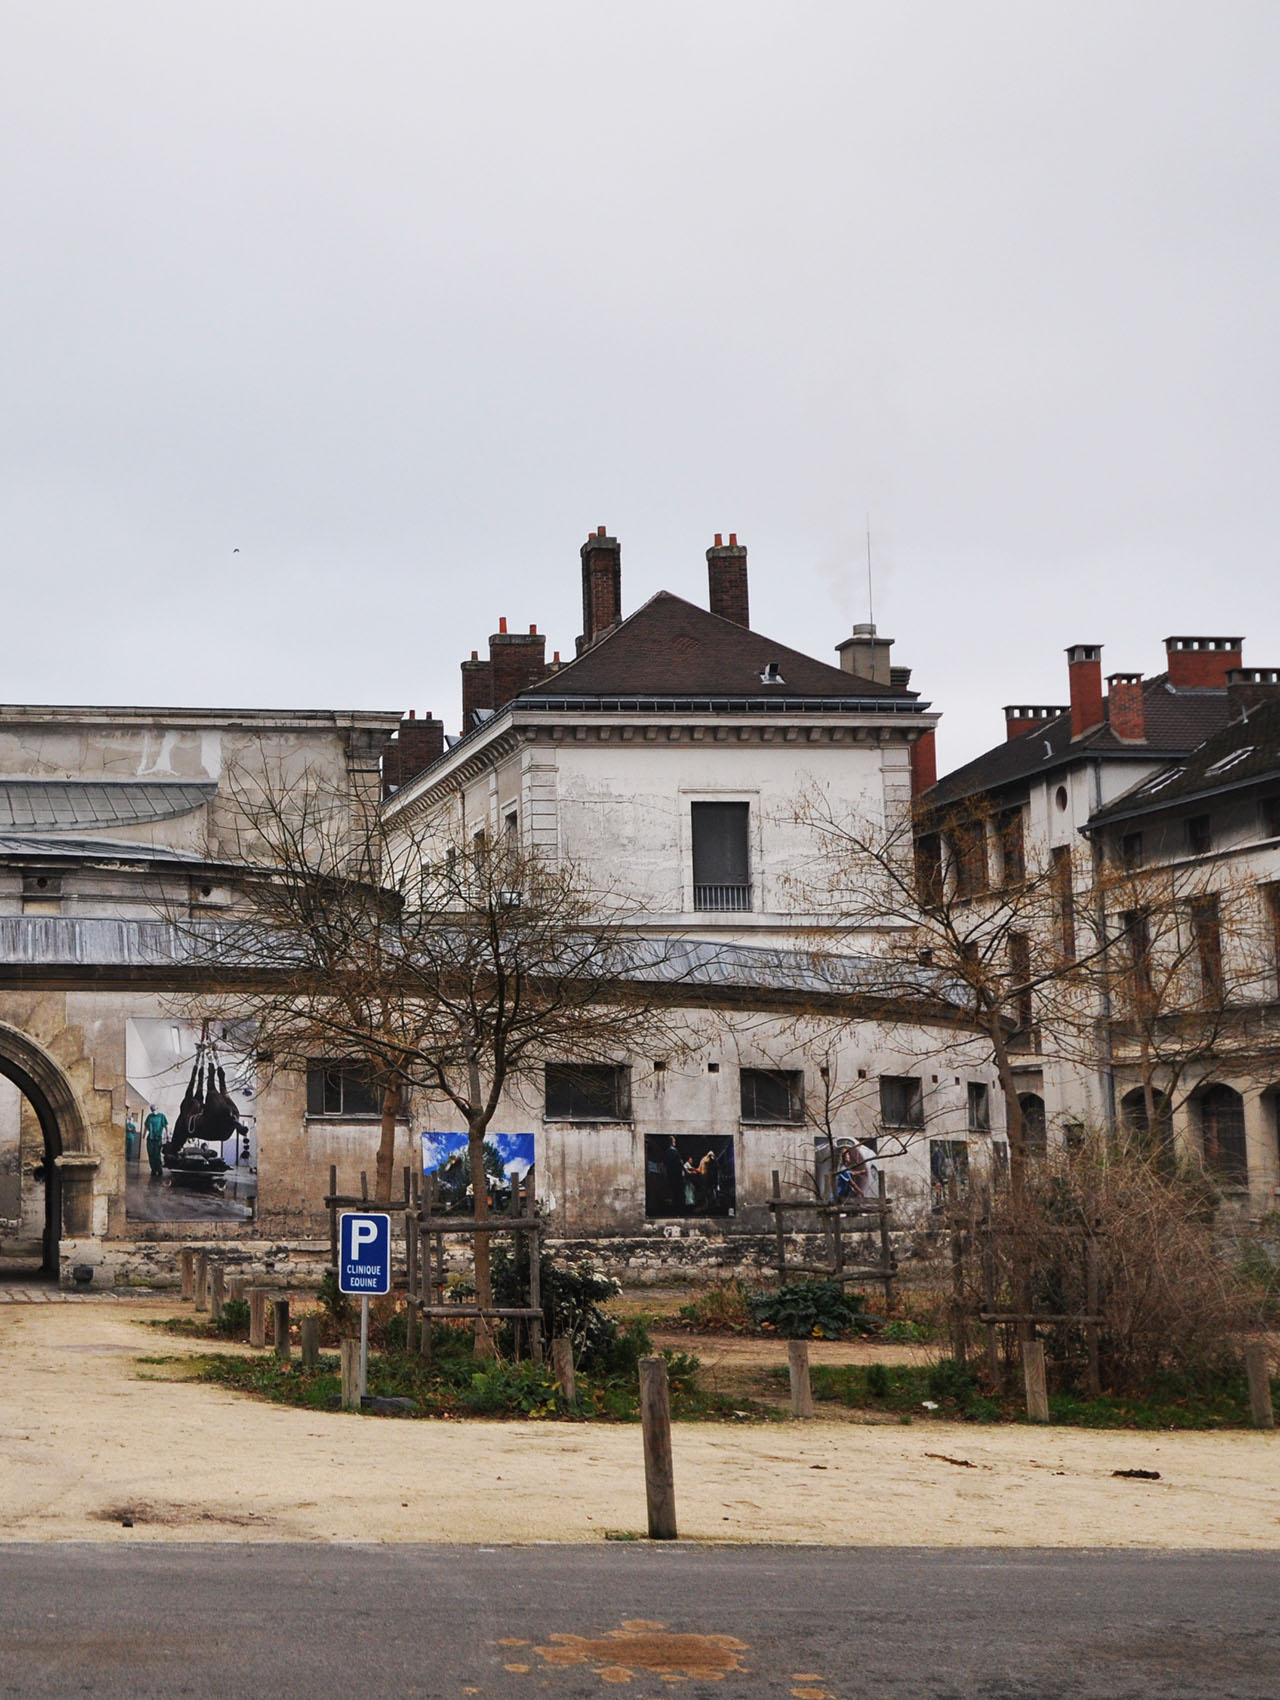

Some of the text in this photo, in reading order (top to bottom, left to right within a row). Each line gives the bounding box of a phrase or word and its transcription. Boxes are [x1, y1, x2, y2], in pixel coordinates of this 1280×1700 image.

[351, 1219, 378, 1261] P
[346, 1264, 382, 1275] CLINIQUE
[350, 1277, 378, 1288] EQUINE
